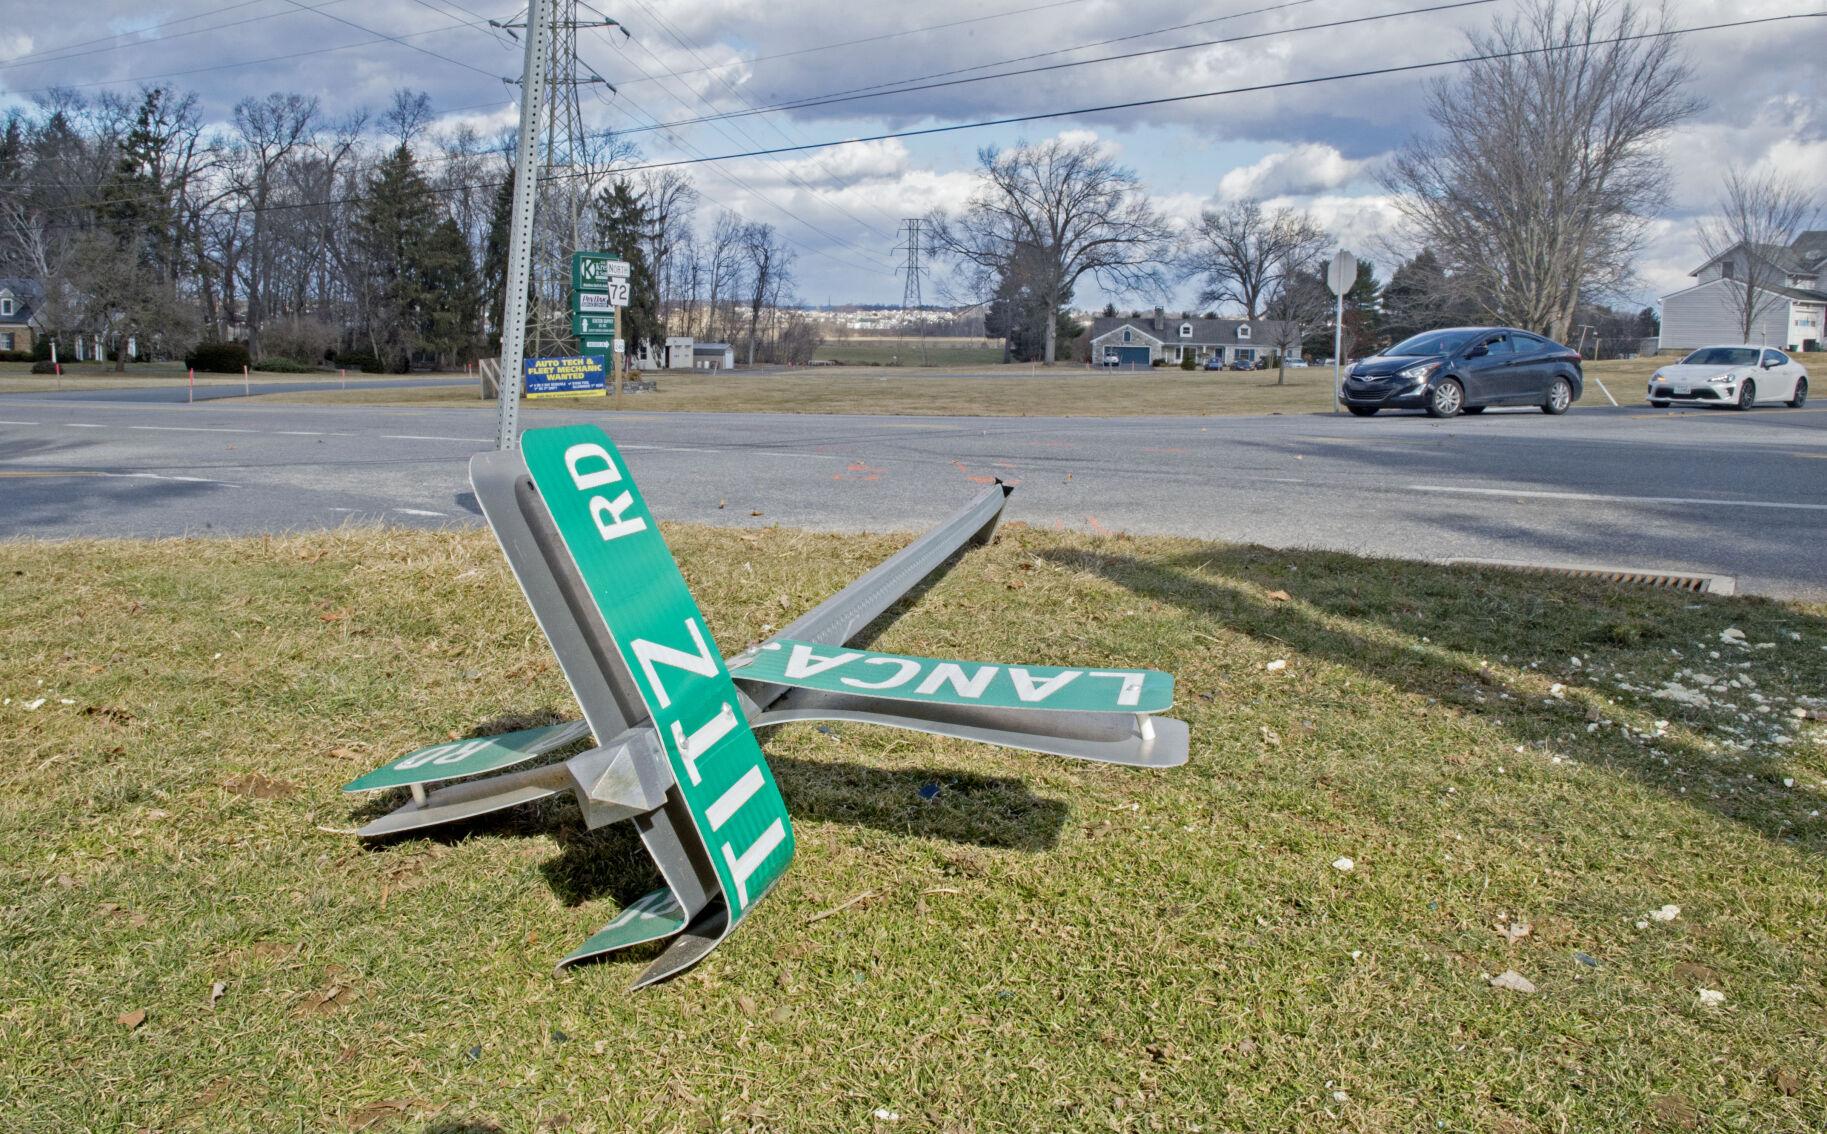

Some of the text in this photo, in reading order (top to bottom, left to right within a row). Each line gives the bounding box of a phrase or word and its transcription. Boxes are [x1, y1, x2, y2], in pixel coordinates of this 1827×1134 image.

[608, 263, 629, 274] NORTH
[610, 284, 628, 300] 72
[535, 357, 594, 368] AUTO TECH &
[527, 364, 603, 375] FLEET MECHANIC
[546, 372, 585, 381] WANTED
[564, 443, 648, 542] RD
[761, 642, 1146, 706] LANCA
[631, 616, 787, 911] TITZ
